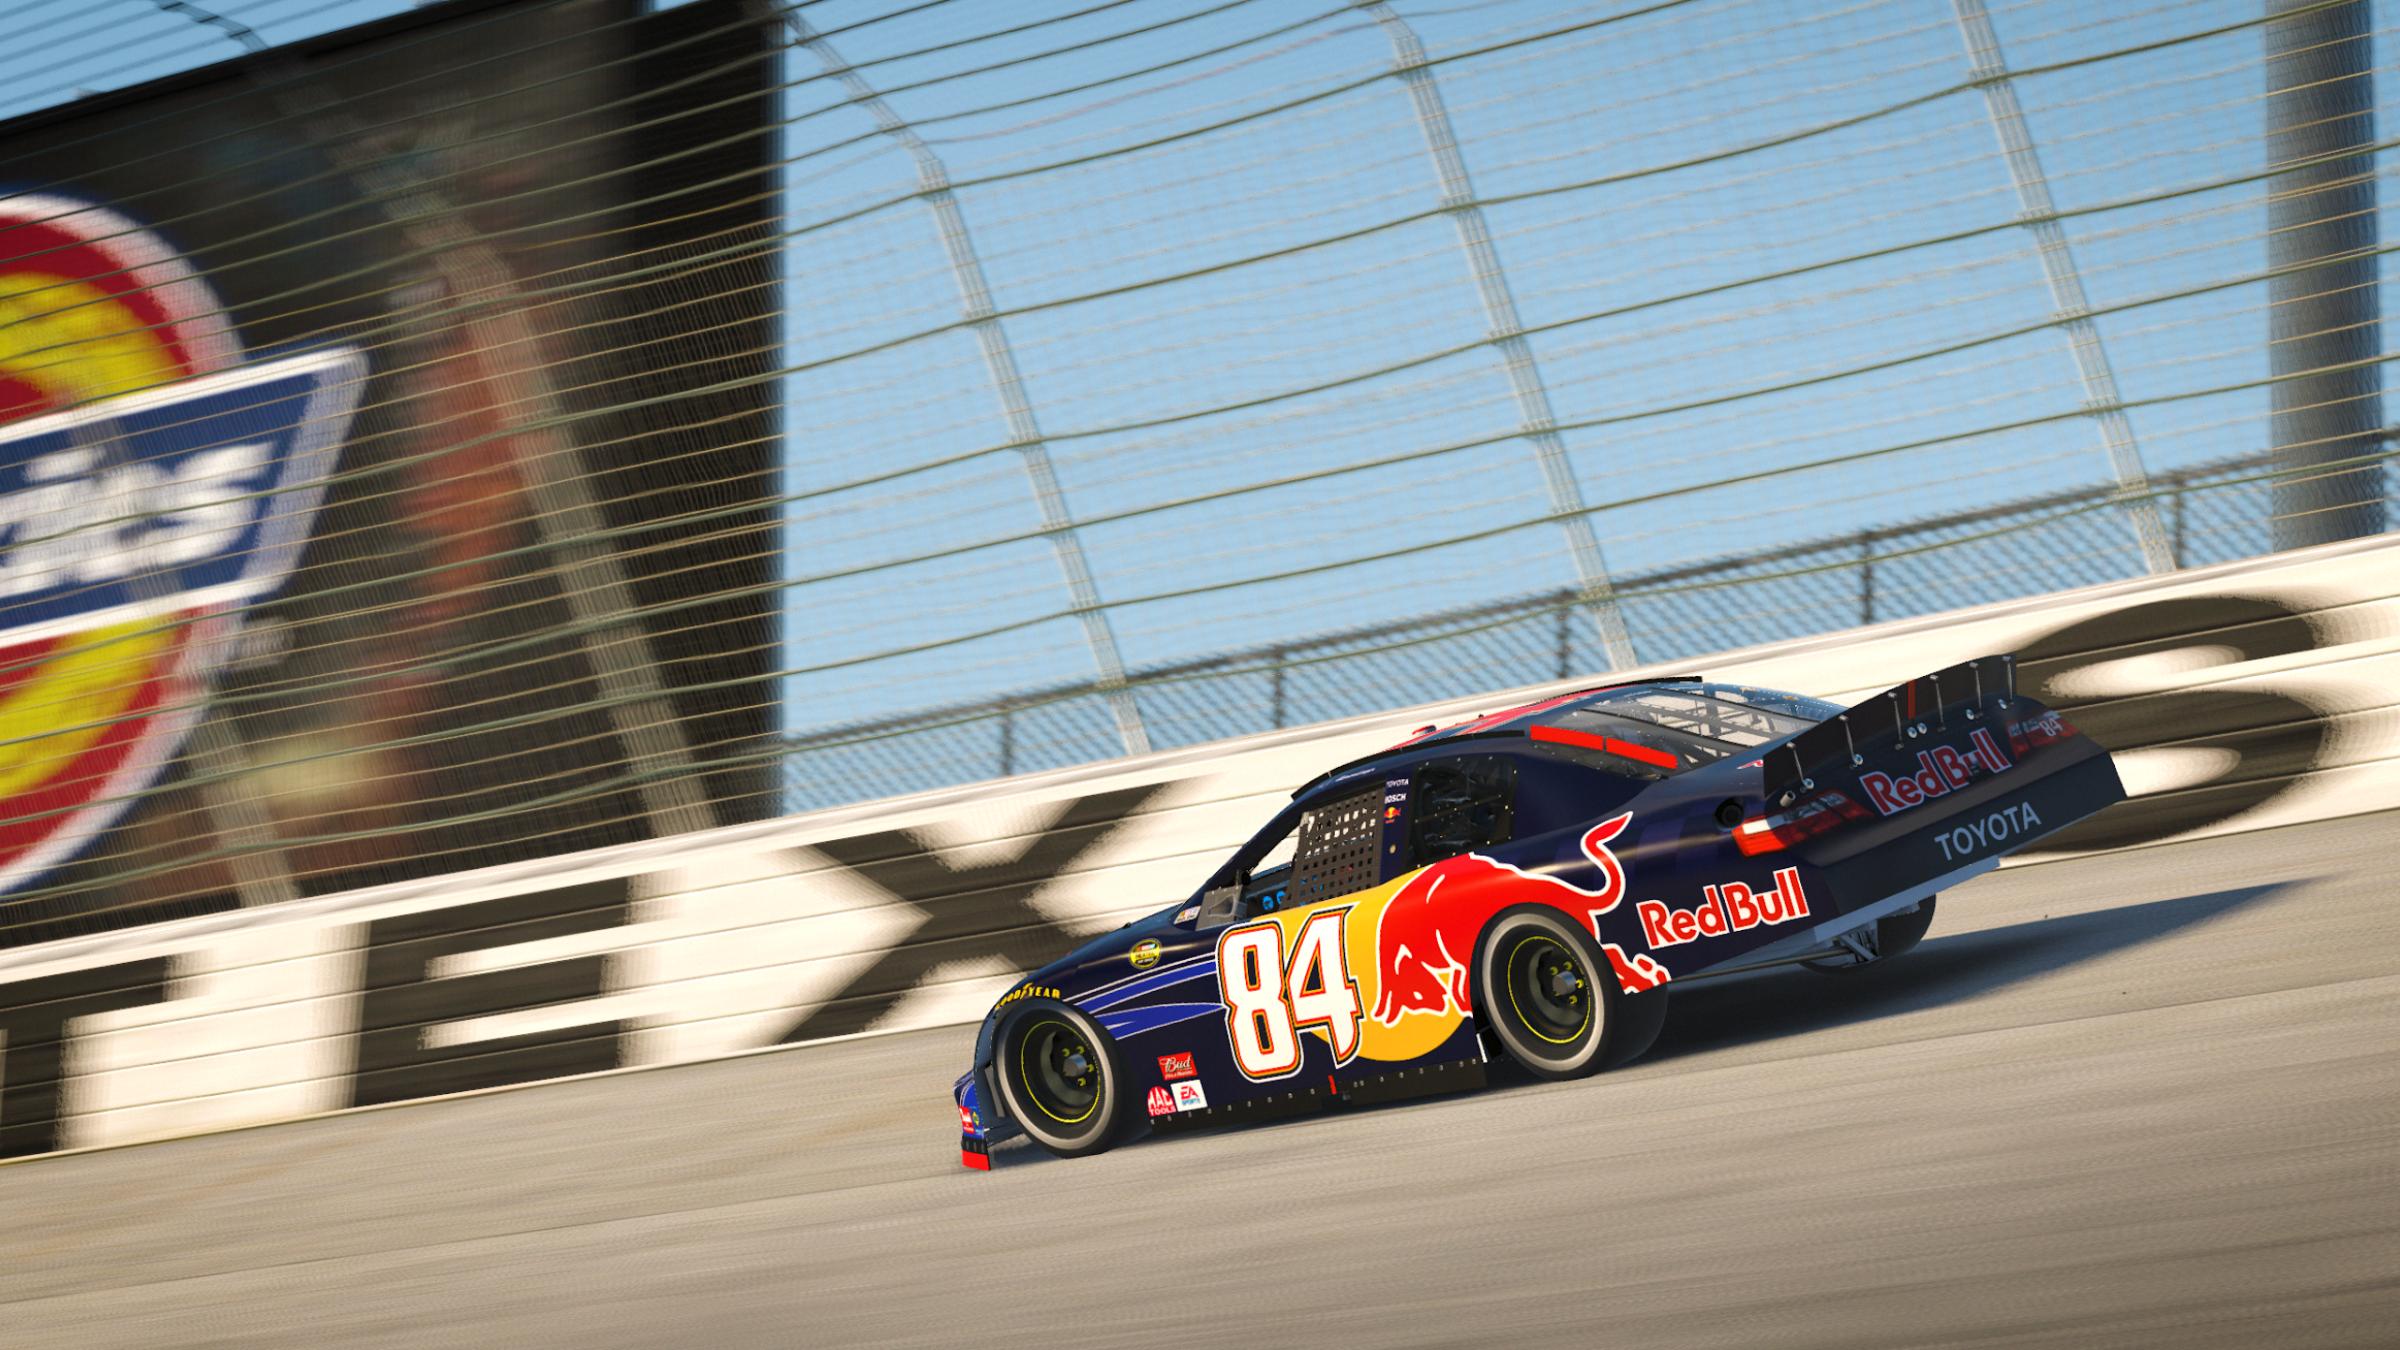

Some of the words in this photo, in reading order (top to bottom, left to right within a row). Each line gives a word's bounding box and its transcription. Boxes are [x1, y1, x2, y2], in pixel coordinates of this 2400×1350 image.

[2039, 718, 2064, 737] 84
[1386, 778, 1409, 788] TOYOTA
[1934, 802, 2041, 862] TOYOTA
[1637, 884, 1727, 950] Red
[1721, 867, 1810, 932] Bull
[1214, 903, 1366, 1083] 84
[1160, 1055, 1191, 1073] Bud
[1148, 1087, 1174, 1109] MAC
[1180, 1085, 1200, 1100] EA
[1150, 1105, 1177, 1116] TOOLS
